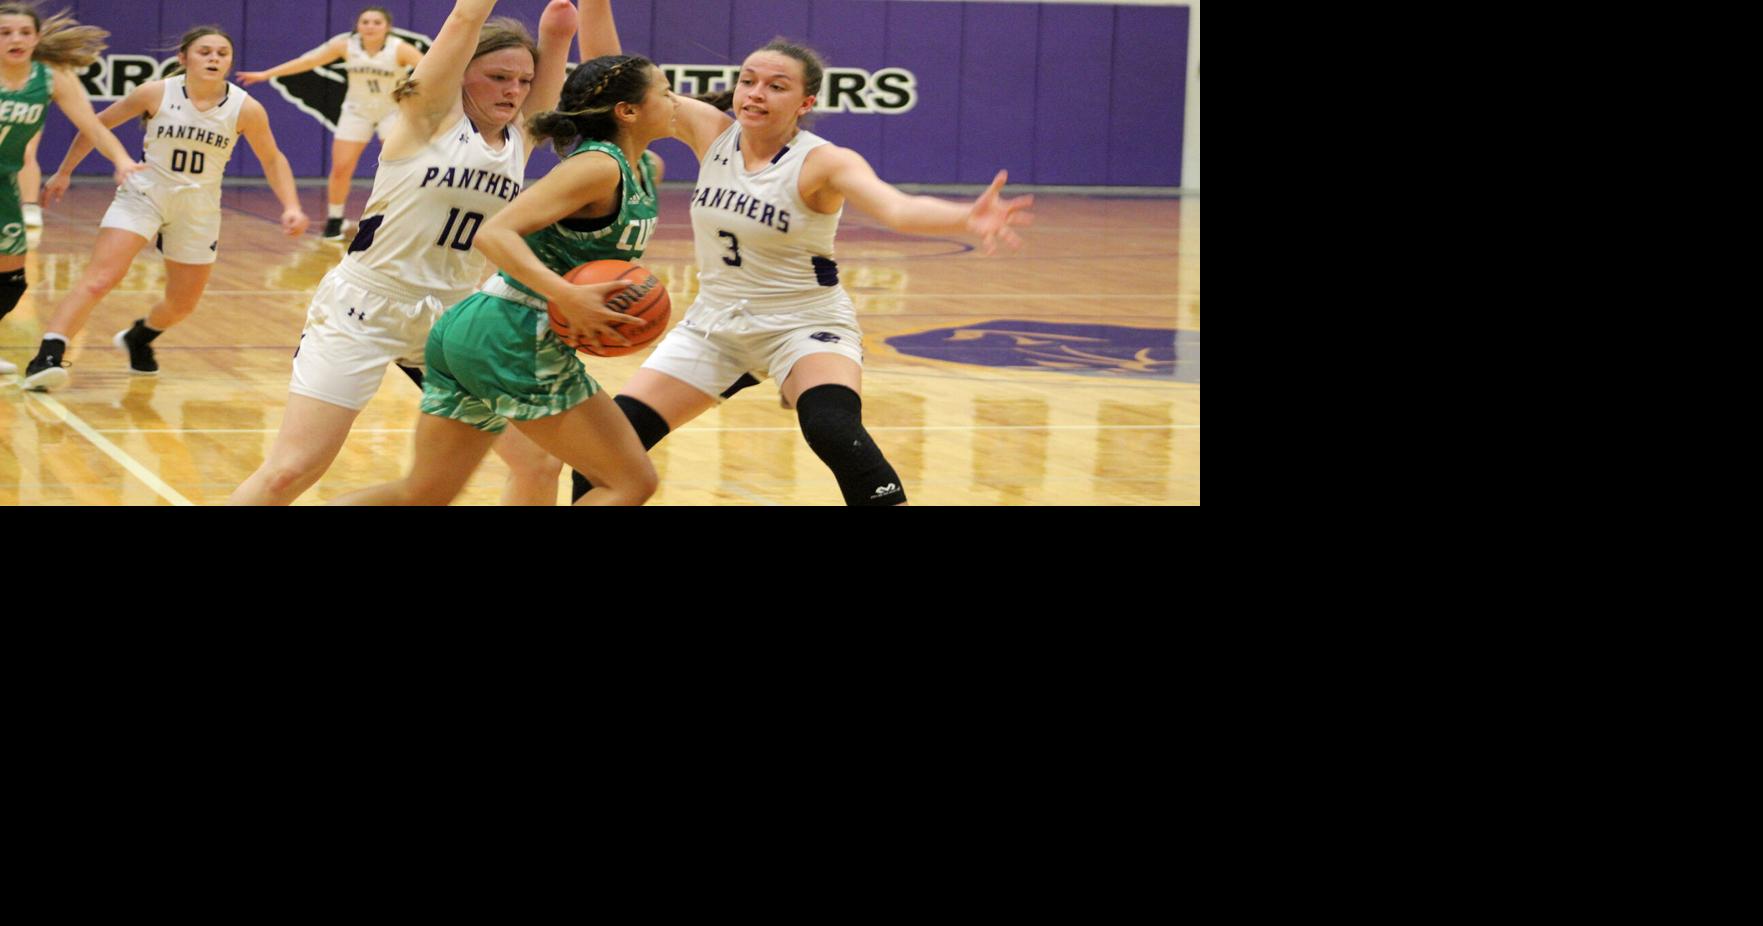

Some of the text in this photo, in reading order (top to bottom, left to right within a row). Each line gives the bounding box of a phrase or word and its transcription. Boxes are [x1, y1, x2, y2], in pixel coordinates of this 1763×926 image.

[157, 125, 230, 149] PANTHERS
[171, 149, 204, 174] 00
[419, 166, 520, 202] PANTHER
[437, 207, 484, 251] 10
[718, 230, 742, 267] 3
